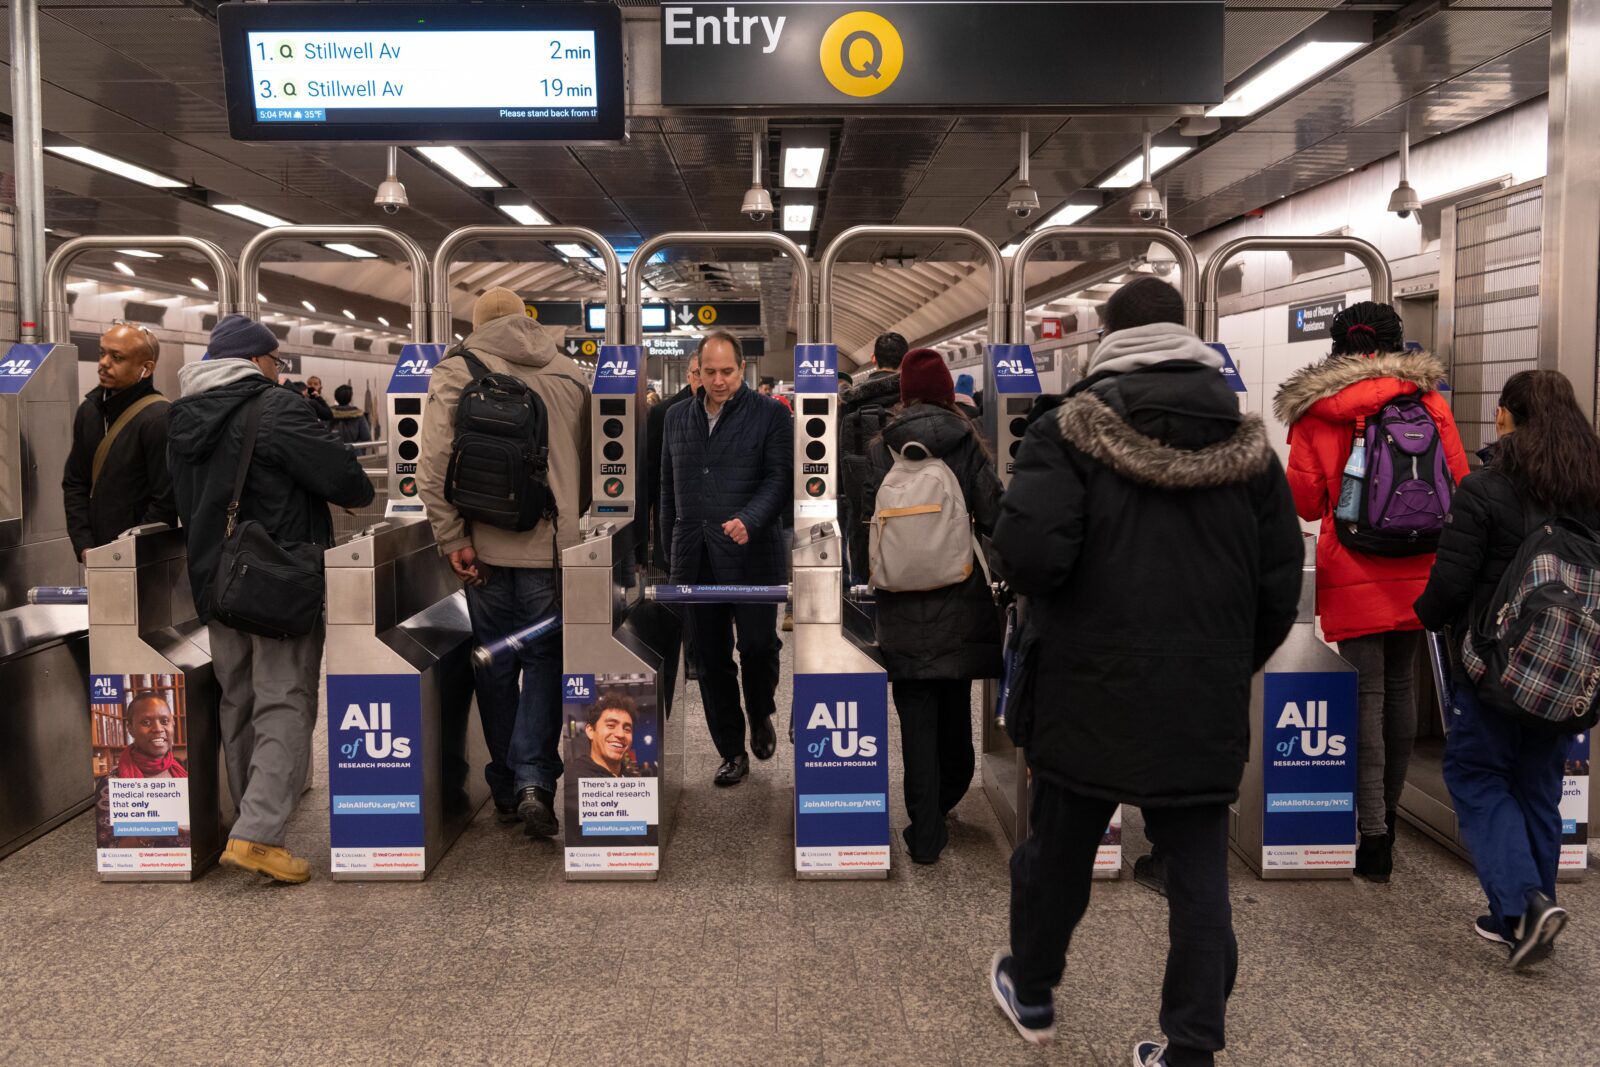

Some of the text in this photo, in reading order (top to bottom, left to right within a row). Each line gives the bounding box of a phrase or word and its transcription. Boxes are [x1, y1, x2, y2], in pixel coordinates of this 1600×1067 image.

[665, 7, 786, 54] Entry
[256, 40, 592, 60] 1. Q Stillwell Av 2 min
[840, 30, 882, 80] Q
[260, 79, 592, 98] 3. Q Stillwell Av 19 min
[260, 110, 277, 119] 5:04
[278, 110, 292, 119] PM
[500, 110, 526, 118] Please
[528, 109, 548, 118] stand
[550, 109, 569, 118] back
[571, 108, 589, 117] from
[702, 310, 712, 320] Q
[654, 340, 678, 348] Street
[649, 348, 684, 356] Brooklyn
[400, 360, 428, 368] All
[996, 360, 1022, 368] All
[396, 464, 416, 472] Entr
[601, 464, 626, 476] Entry
[803, 464, 828, 474] Entry
[94, 678, 111, 687] All
[567, 677, 583, 687] All
[102, 686, 118, 696] Us
[575, 686, 590, 696] Us
[340, 703, 391, 730] All
[806, 701, 858, 729] All
[1276, 701, 1327, 728] All
[341, 732, 411, 759] of Us
[807, 730, 878, 758] of Us
[1276, 730, 1346, 757] of Us
[131, 800, 149, 809] only
[600, 800, 618, 808] only
[113, 812, 128, 820] you
